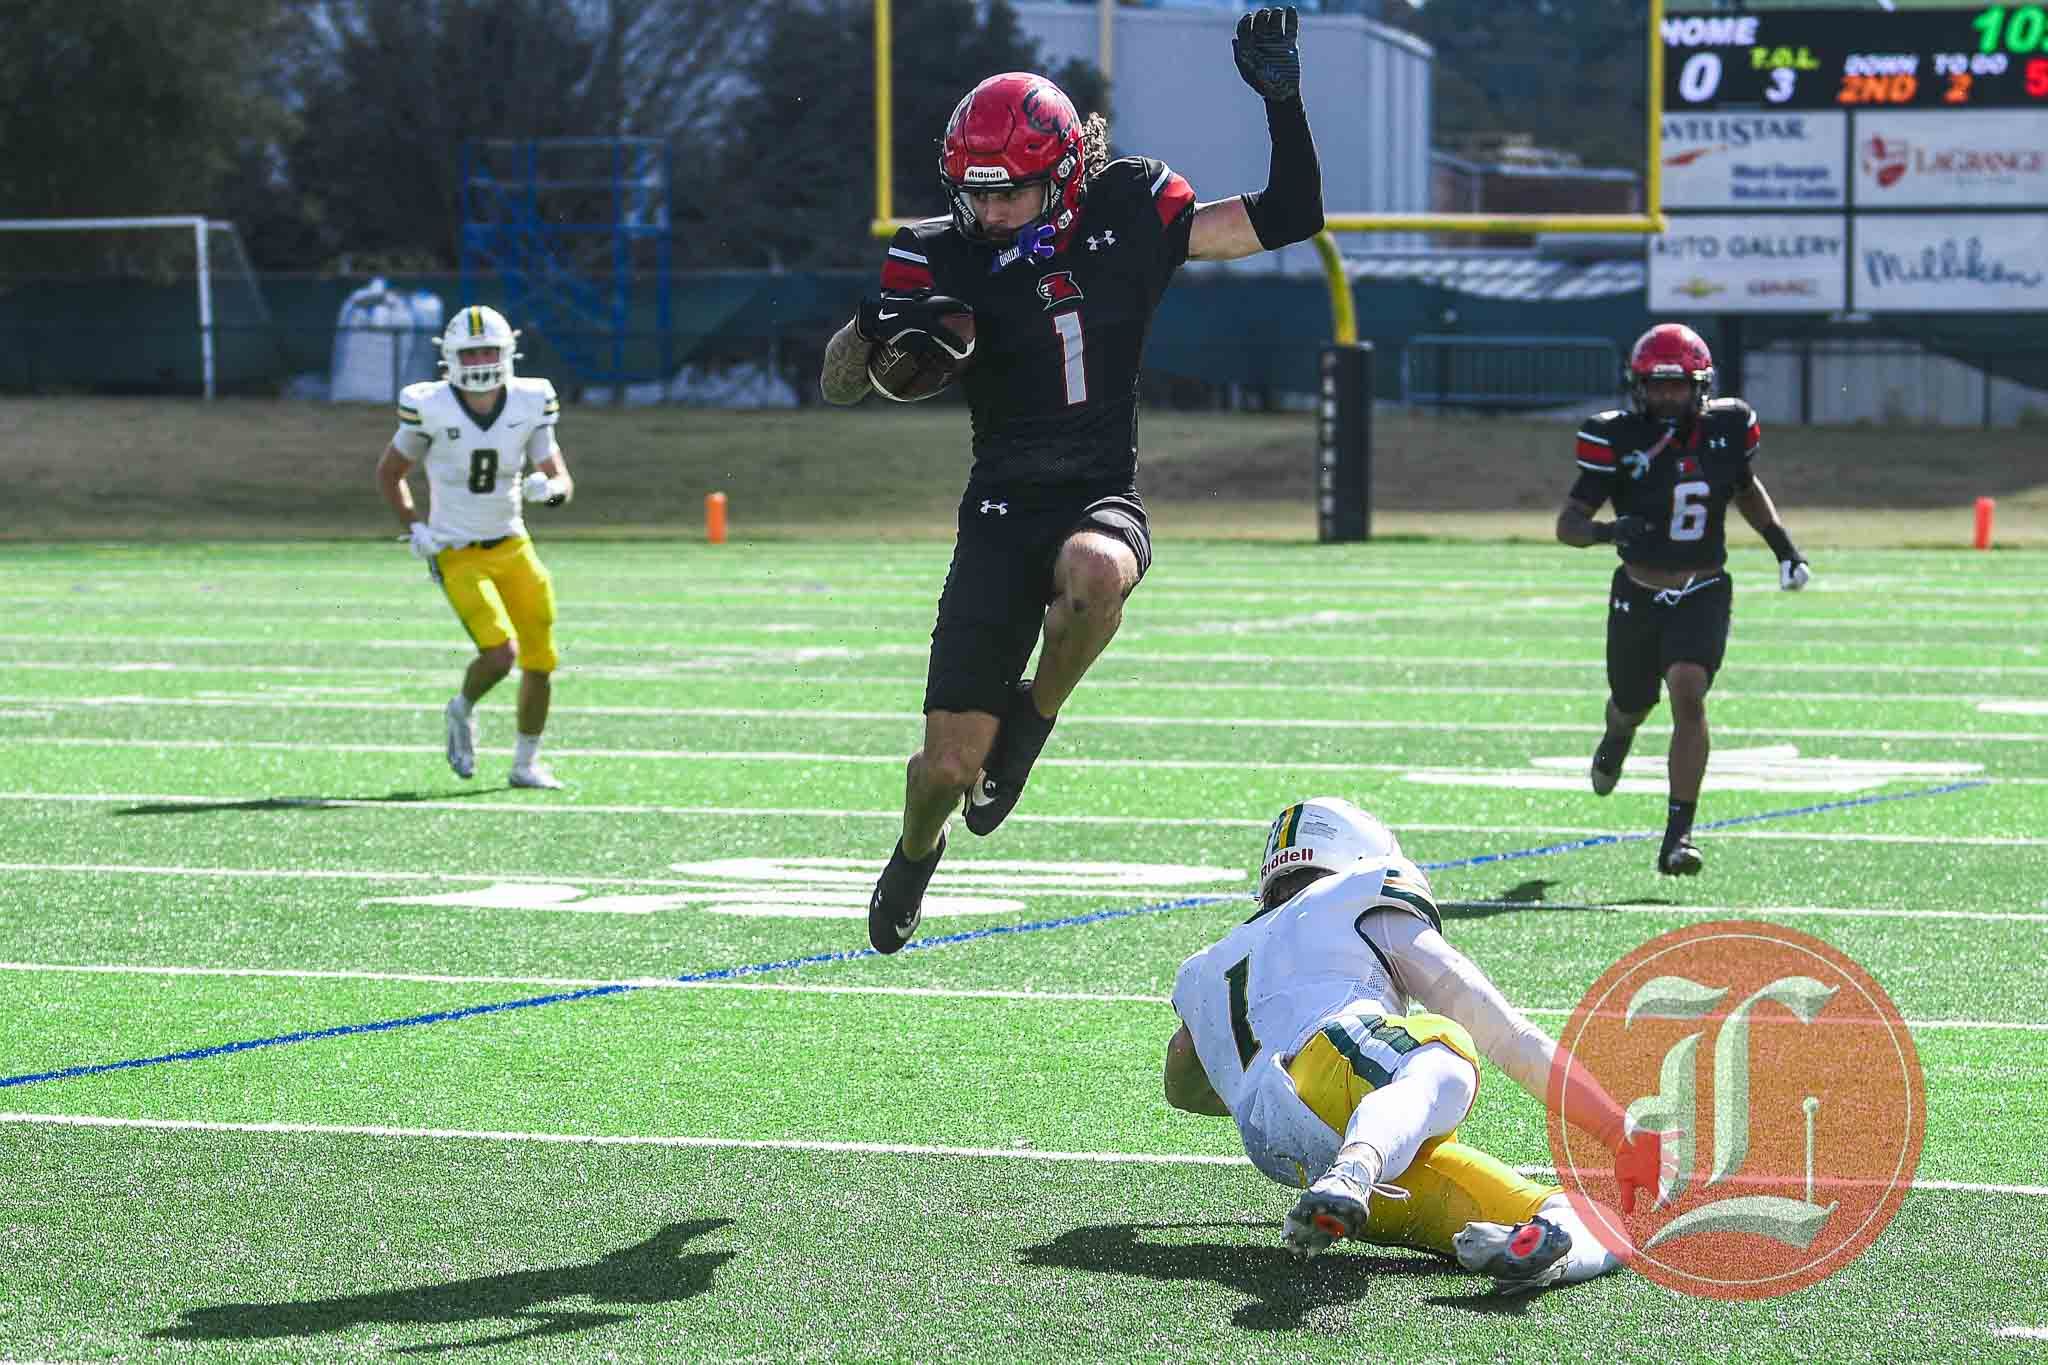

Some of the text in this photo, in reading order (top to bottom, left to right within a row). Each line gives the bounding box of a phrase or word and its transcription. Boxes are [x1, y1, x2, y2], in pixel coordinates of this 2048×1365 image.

[1661, 17, 1759, 46] HOME
[1680, 53, 1722, 101] 0
[1766, 68, 1796, 101] 3
[1837, 74, 1917, 102] 2ND
[1944, 74, 1971, 102] 2
[968, 169, 1003, 179] Riddell
[953, 196, 976, 224] Riddell
[1727, 235, 1842, 260] GALLERY
[1863, 236, 2044, 289] Milliken
[1053, 310, 1087, 406] 1
[467, 448, 499, 495] 8
[1669, 480, 1710, 541] 6
[1260, 848, 1314, 880] Riddell
[1223, 952, 1264, 1073] 1
